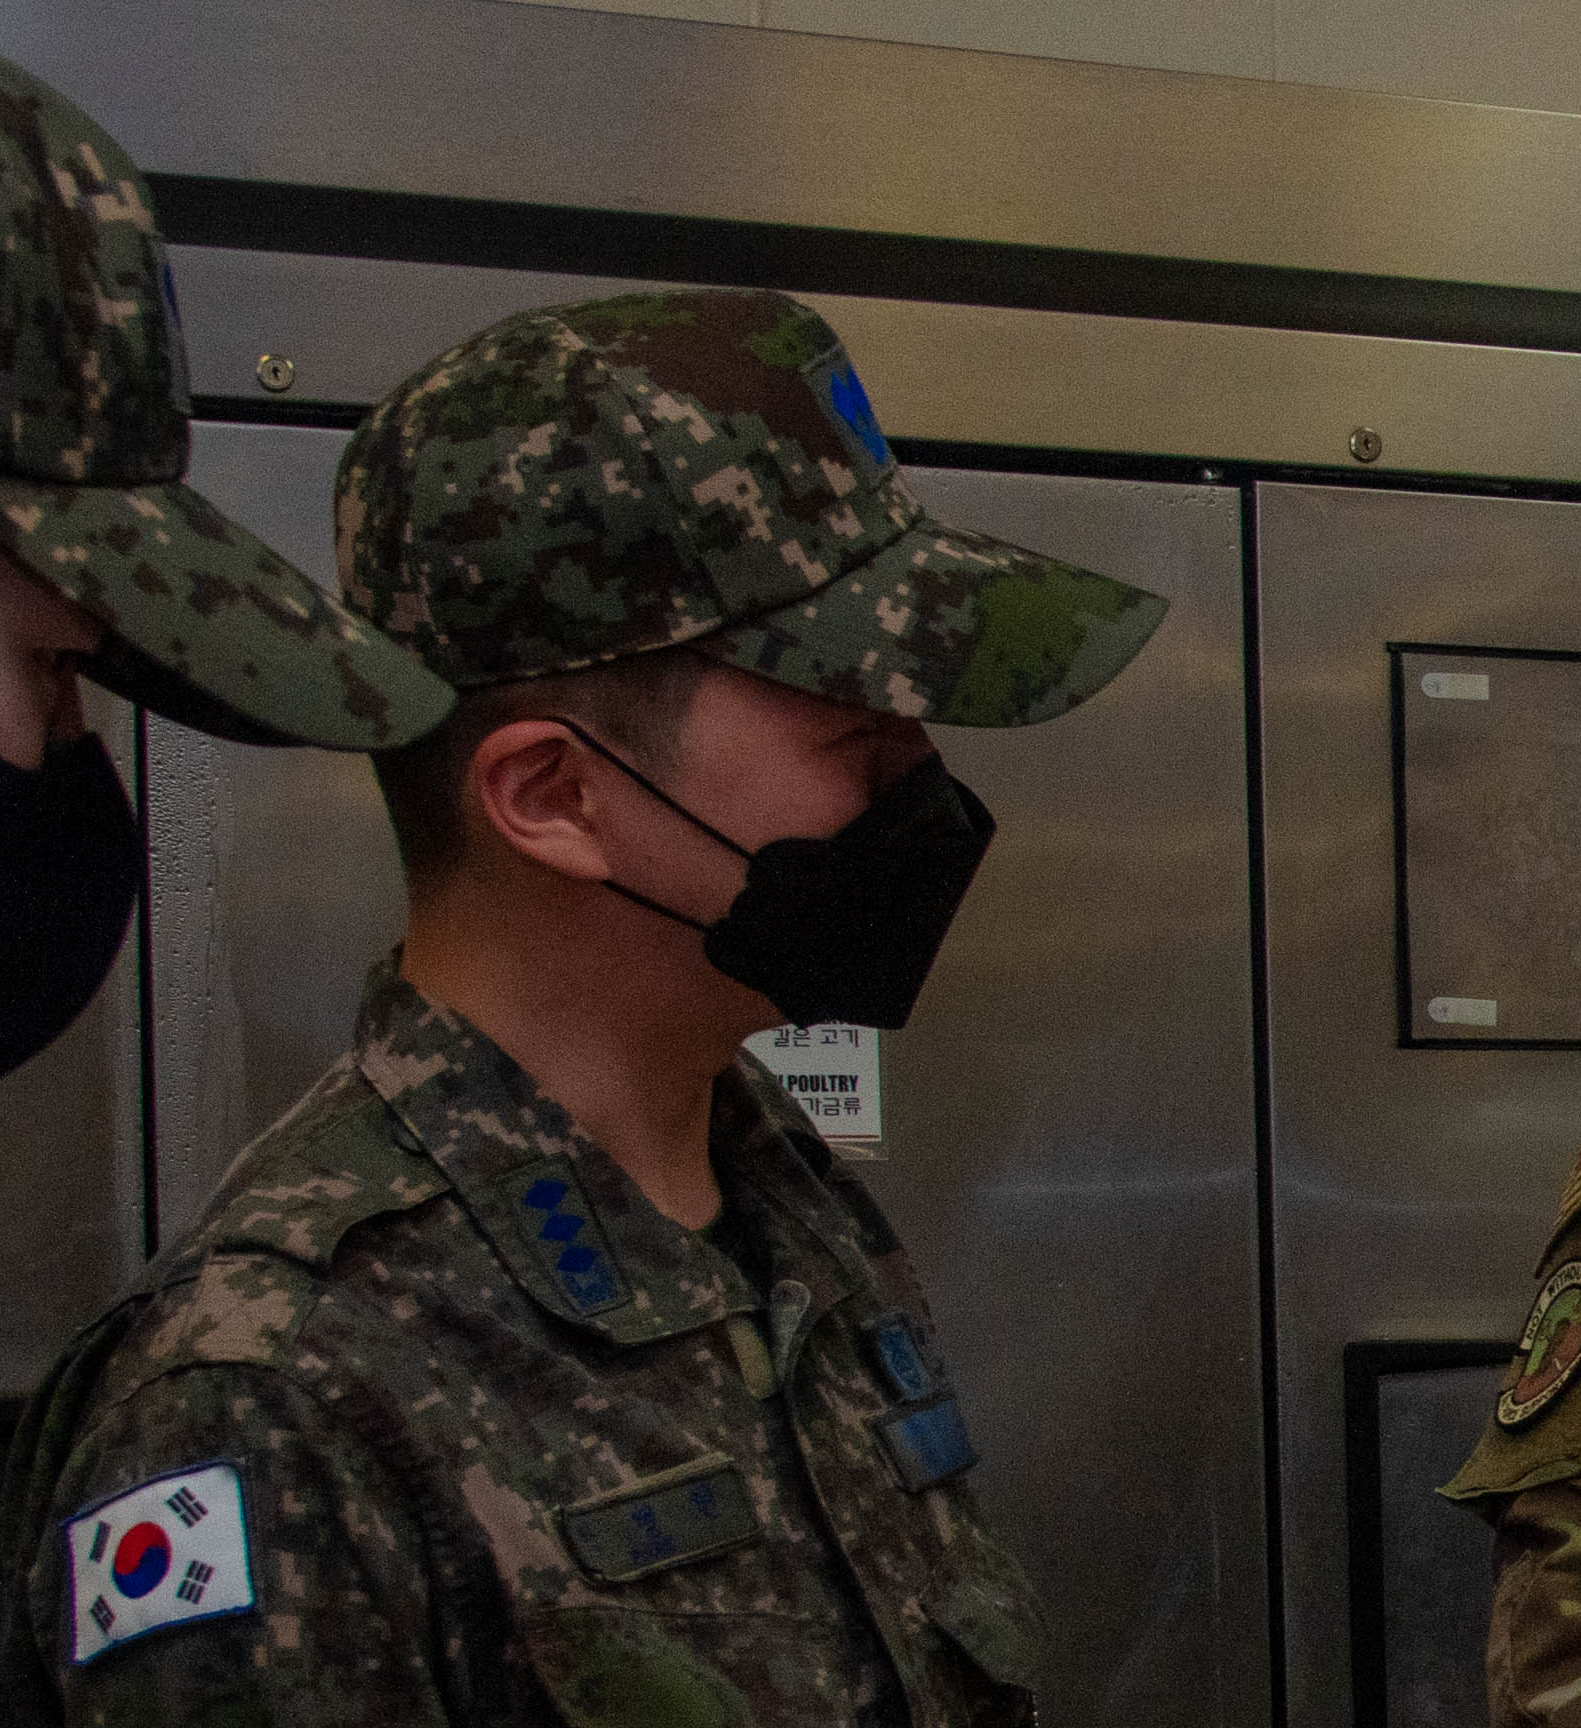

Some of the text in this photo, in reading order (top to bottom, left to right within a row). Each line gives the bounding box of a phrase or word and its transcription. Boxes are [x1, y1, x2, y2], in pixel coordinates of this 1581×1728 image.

[820, 1029, 859, 1048] 고기
[787, 1074, 859, 1092] POULTRY
[801, 1097, 862, 1116] 가금류
[1526, 1305, 1543, 1340] NOT
